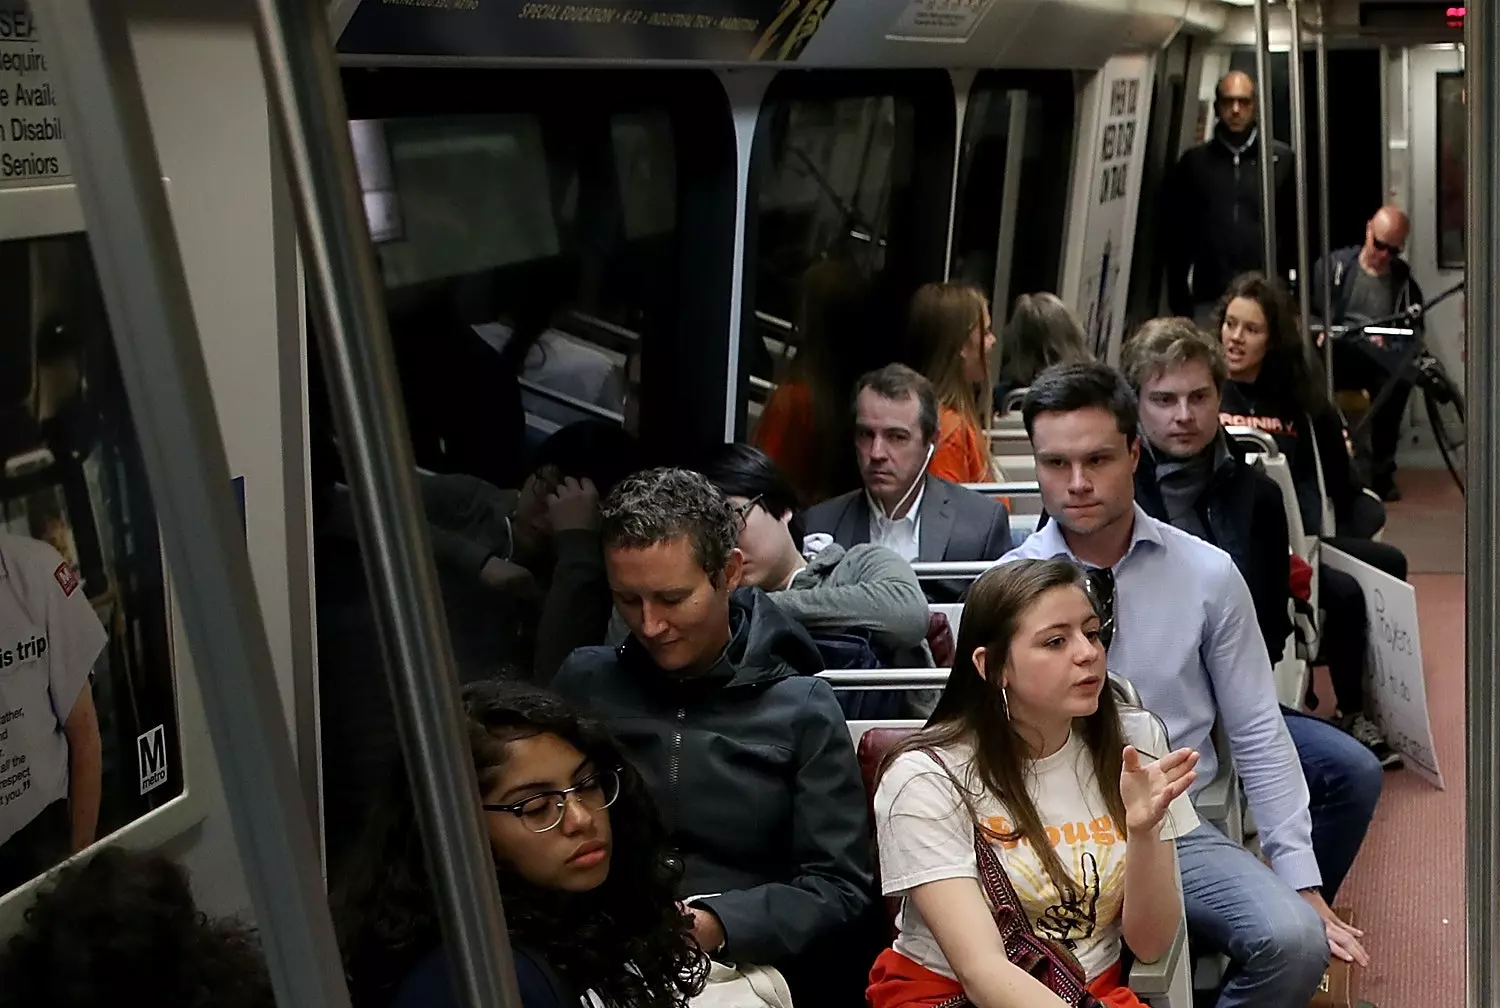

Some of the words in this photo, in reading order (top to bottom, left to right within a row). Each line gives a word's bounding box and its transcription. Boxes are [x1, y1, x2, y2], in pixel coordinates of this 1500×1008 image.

[10, 118, 63, 142] Disabil
[2, 153, 60, 177] Seniors
[16, 635, 47, 661] trip
[142, 770, 166, 790] metro
